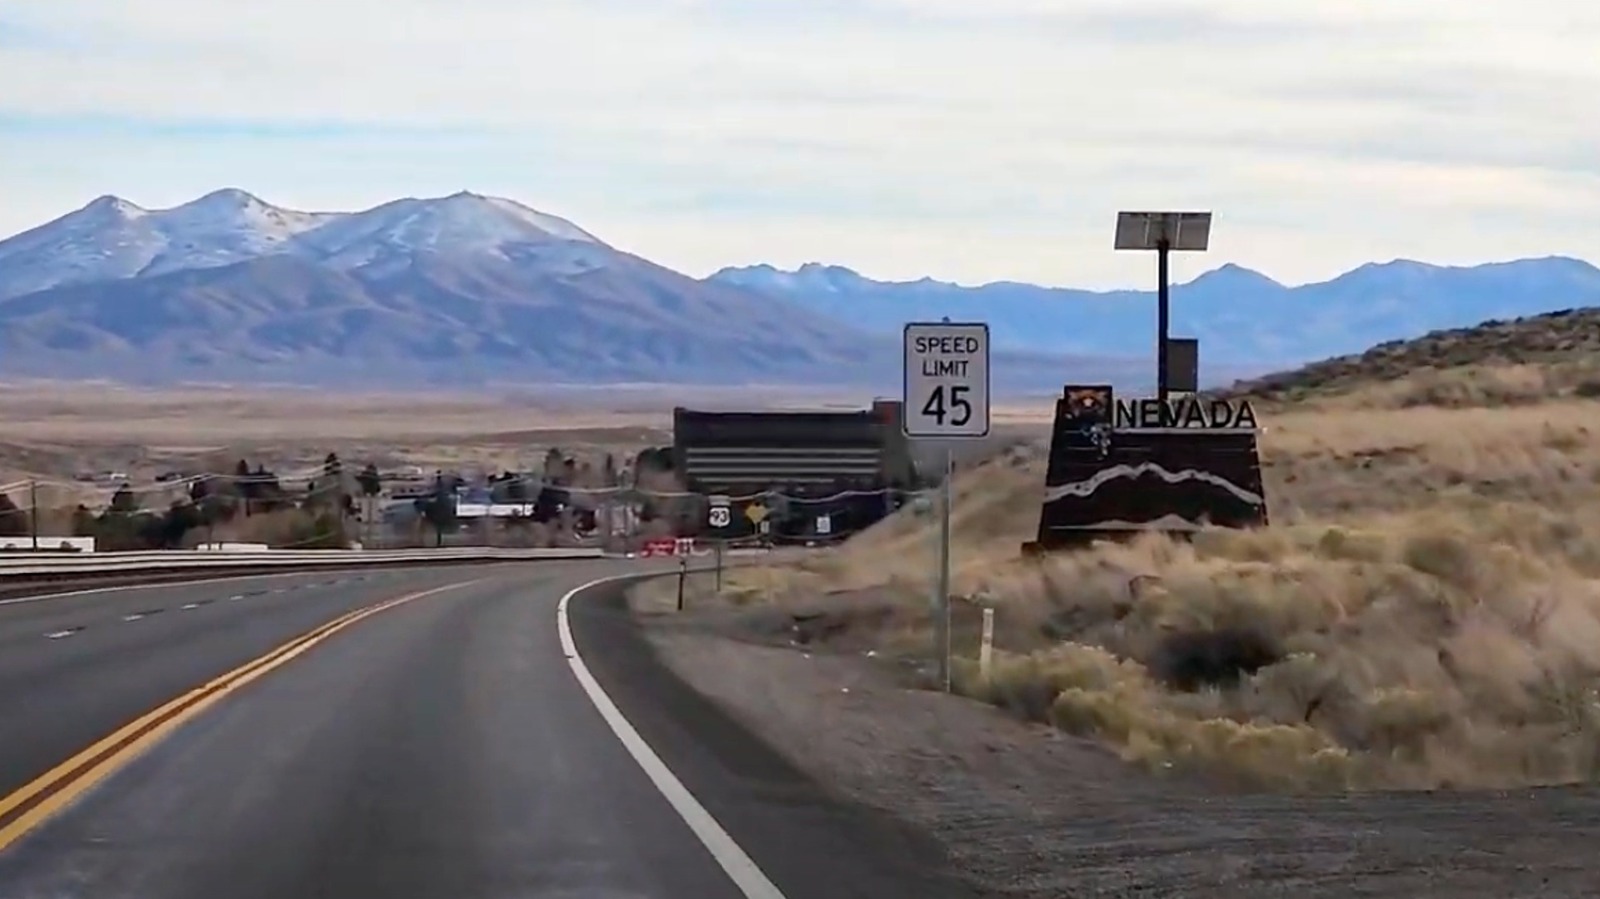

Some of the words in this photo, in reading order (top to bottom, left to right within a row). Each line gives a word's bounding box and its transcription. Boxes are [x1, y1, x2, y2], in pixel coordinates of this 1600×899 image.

[915, 336, 978, 353] SPEED
[922, 360, 968, 376] LIMIT
[921, 385, 972, 426] 45
[1115, 399, 1258, 428] NEVADA
[710, 510, 727, 523] 93
